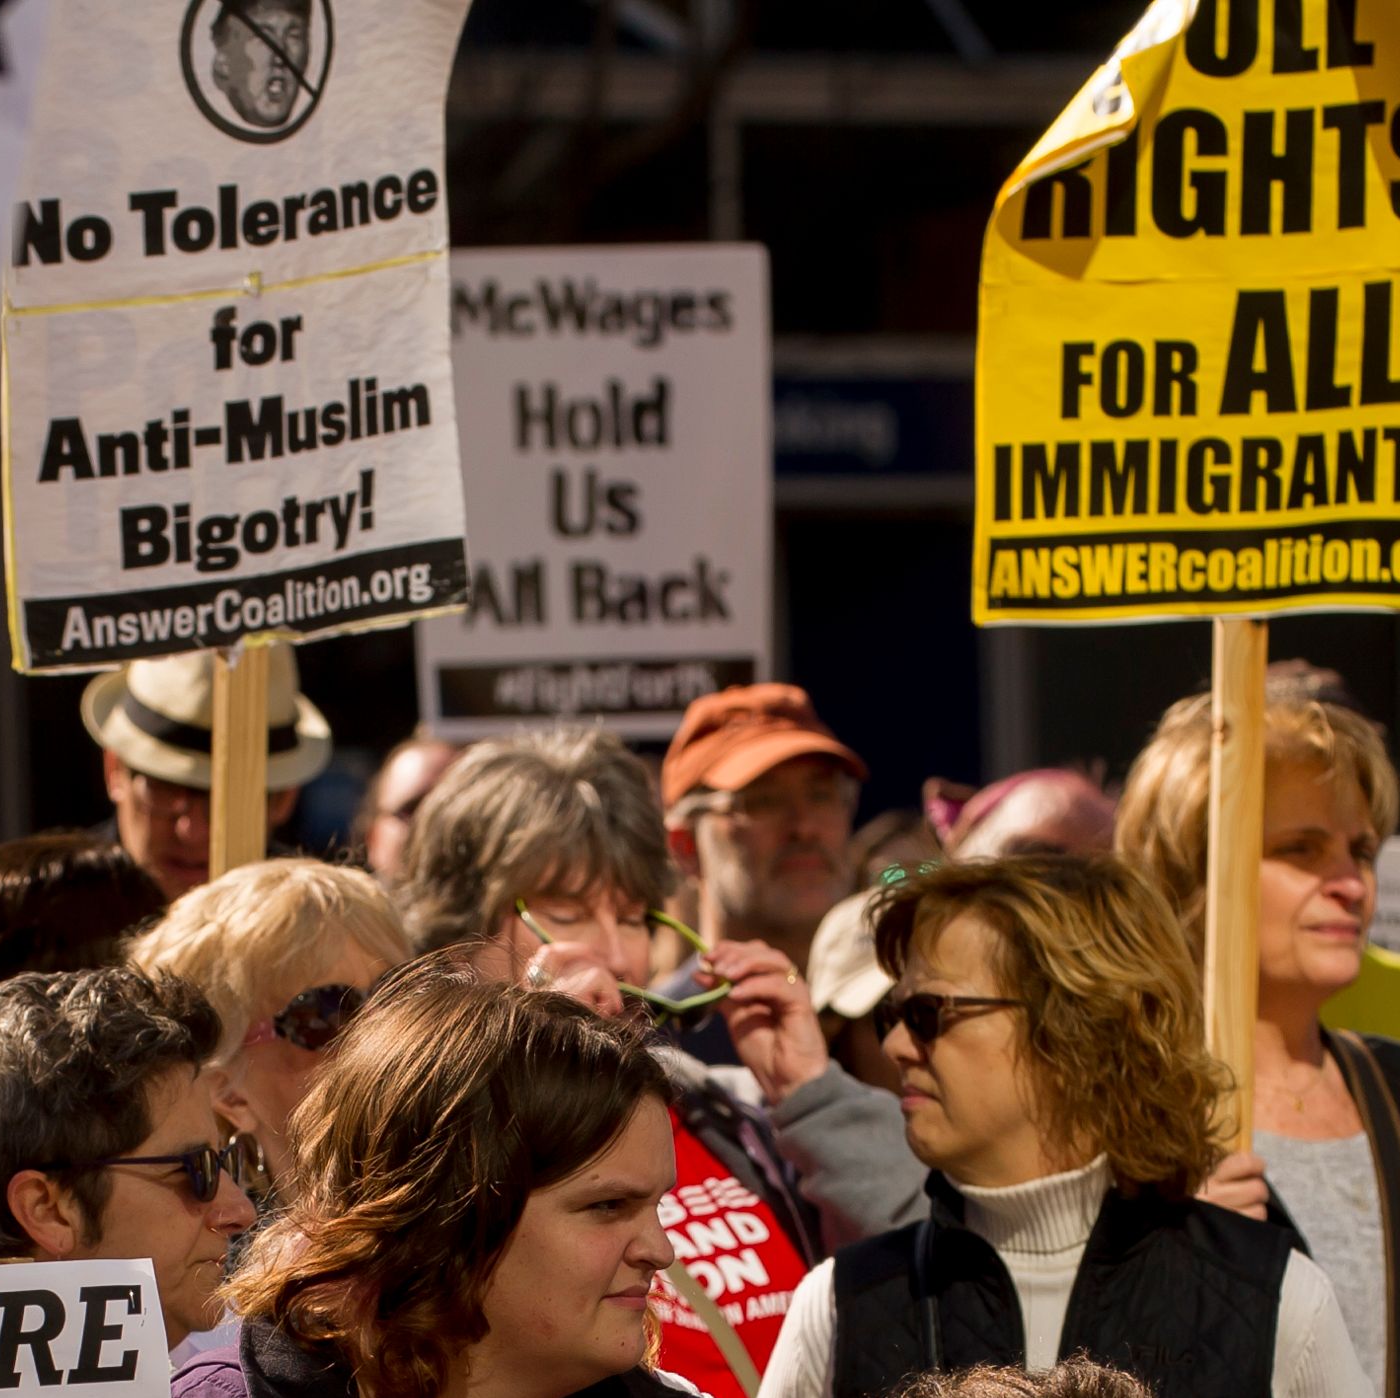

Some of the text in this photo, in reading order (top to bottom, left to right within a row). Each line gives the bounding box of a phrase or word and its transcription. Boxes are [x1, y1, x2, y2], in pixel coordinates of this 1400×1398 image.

[13, 168, 438, 267] No Tolerance
[211, 306, 303, 371] for
[451, 279, 734, 347] McWages
[512, 377, 672, 450] Hold
[1061, 339, 1199, 420] FOR
[37, 377, 431, 483] Anti-Muslim
[120, 468, 375, 571] Bigotry!
[550, 468, 644, 538] Us
[61, 562, 434, 651] AnswerCoalition.org
[463, 554, 732, 629] All Back
